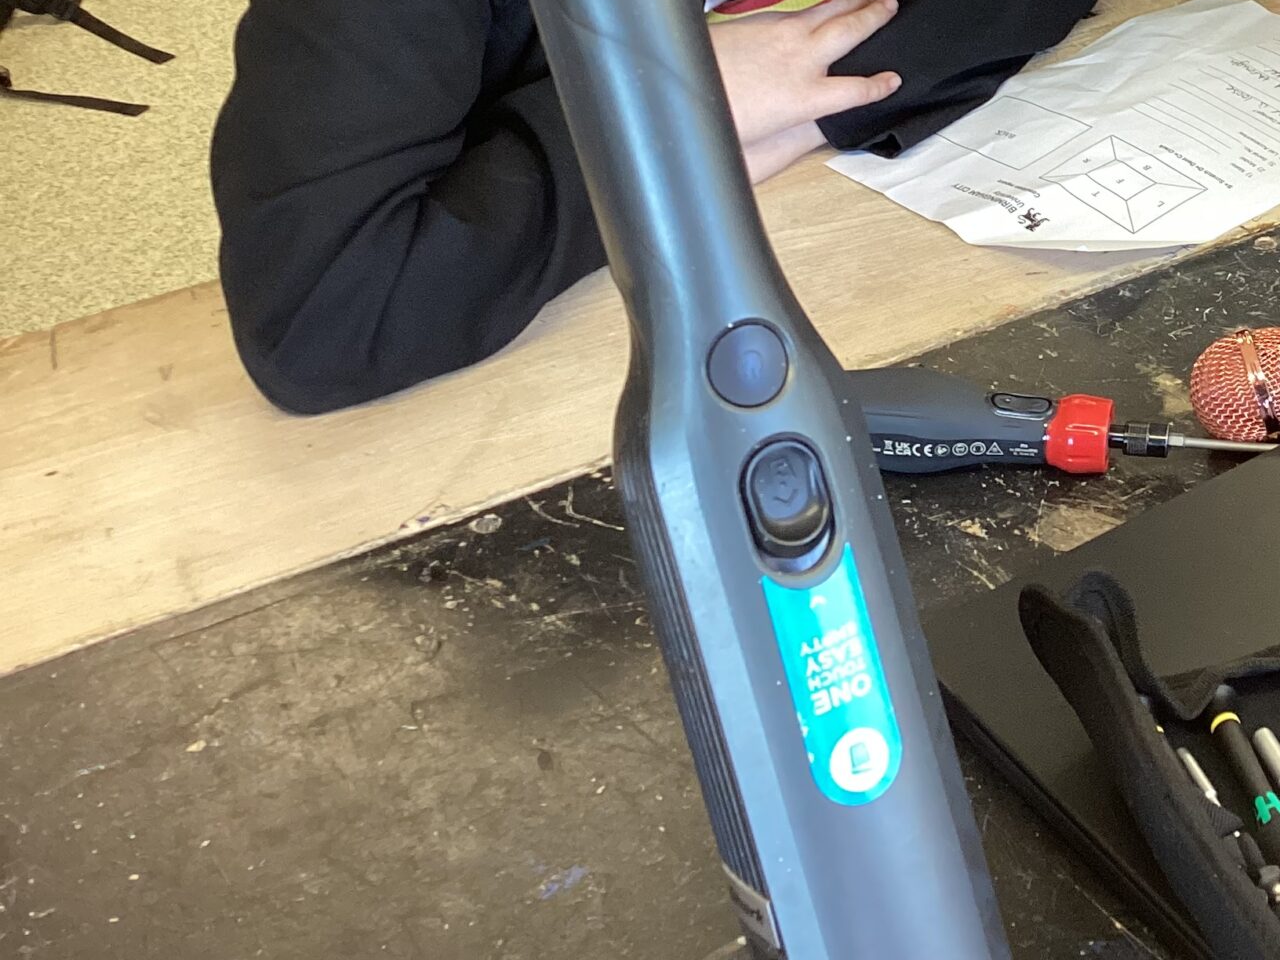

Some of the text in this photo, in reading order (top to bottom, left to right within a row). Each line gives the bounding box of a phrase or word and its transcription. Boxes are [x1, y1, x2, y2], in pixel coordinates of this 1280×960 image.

[951, 183, 1018, 214] BIRMINGHAM CITY
[993, 191, 1025, 208] University
[1157, 200, 1165, 208] L
[806, 638, 862, 677] EASY
[807, 657, 865, 691] TOUCH
[811, 673, 871, 716] ONE
